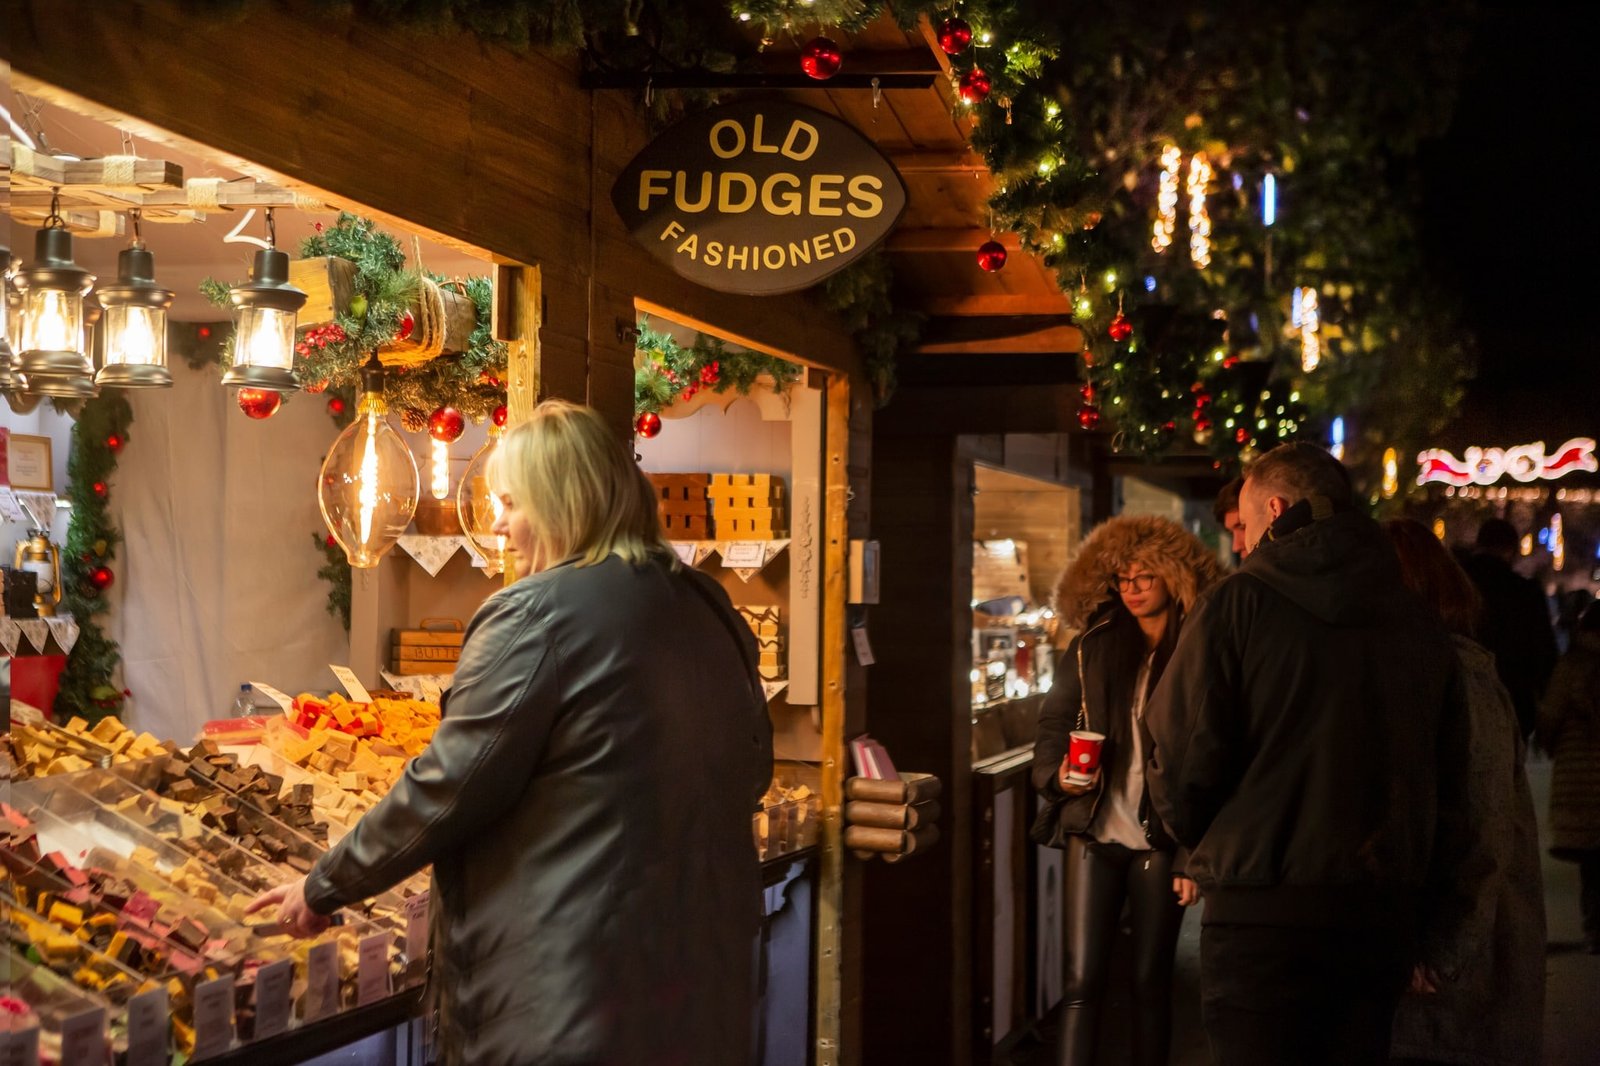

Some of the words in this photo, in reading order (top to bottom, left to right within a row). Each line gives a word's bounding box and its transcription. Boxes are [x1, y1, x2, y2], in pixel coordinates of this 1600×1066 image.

[709, 113, 819, 161] OLD
[639, 170, 883, 218] FUDGES
[660, 221, 856, 271] FASHIONED
